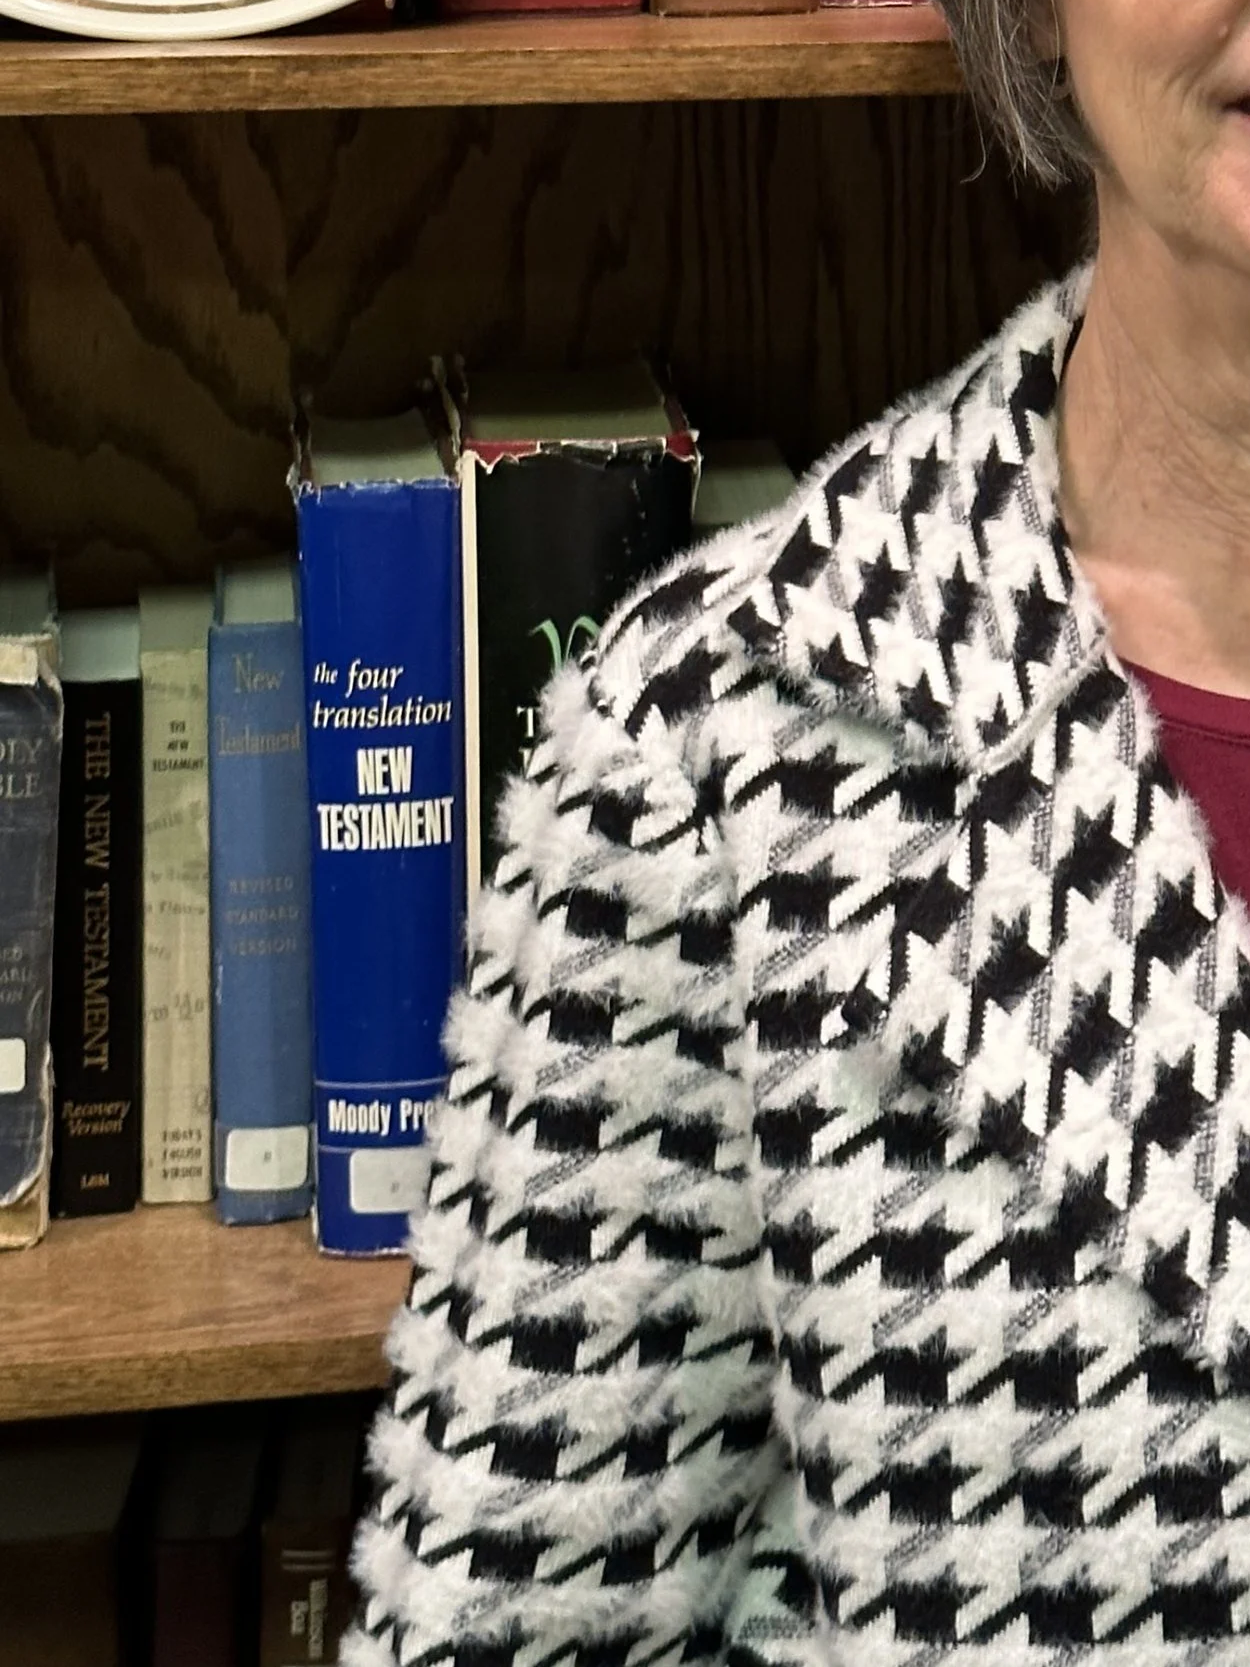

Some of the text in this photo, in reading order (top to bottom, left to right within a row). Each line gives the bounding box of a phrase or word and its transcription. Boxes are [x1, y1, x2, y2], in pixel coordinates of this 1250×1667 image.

[231, 652, 285, 694] New
[314, 658, 404, 698] the four
[312, 695, 452, 729] translation
[215, 715, 302, 758] Testament
[356, 745, 413, 796] NEW
[317, 796, 454, 851] TESTAMENT
[84, 712, 111, 1070] THE NEW TESTAMENT
[229, 875, 294, 895] REVISED
[224, 906, 300, 926] STANDARD
[233, 936, 298, 957] VERSION
[62, 1100, 131, 1119] Recovery
[69, 1119, 122, 1135] Version
[328, 1098, 391, 1137] Moody
